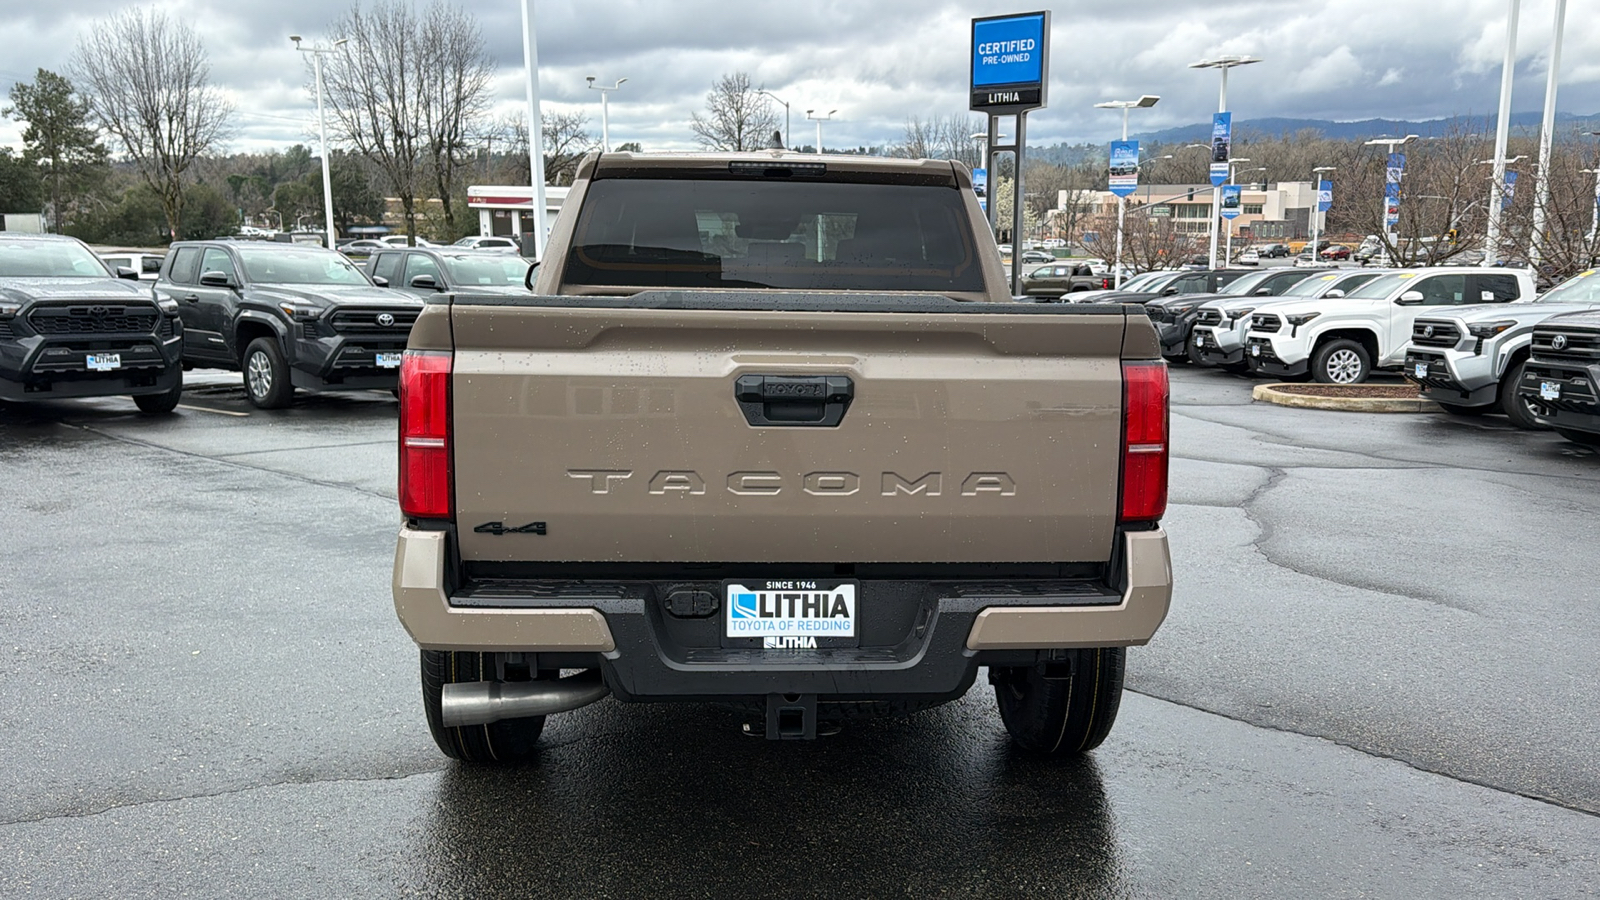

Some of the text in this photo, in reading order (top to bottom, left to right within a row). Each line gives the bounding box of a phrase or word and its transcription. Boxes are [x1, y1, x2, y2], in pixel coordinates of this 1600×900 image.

[978, 39, 1035, 55] CERTIFIED
[982, 53, 1030, 65] PRE-OWNED
[988, 92, 1020, 103] LITHIA
[95, 356, 119, 364] LITHIA
[766, 383, 823, 395] TOYOTA
[567, 469, 1016, 496] TACOMA
[766, 581, 817, 589] SINCE 1946
[759, 594, 850, 618] LITHIA
[732, 620, 851, 631] TOYOTA OF REDDING
[776, 636, 818, 649] LITHIA
